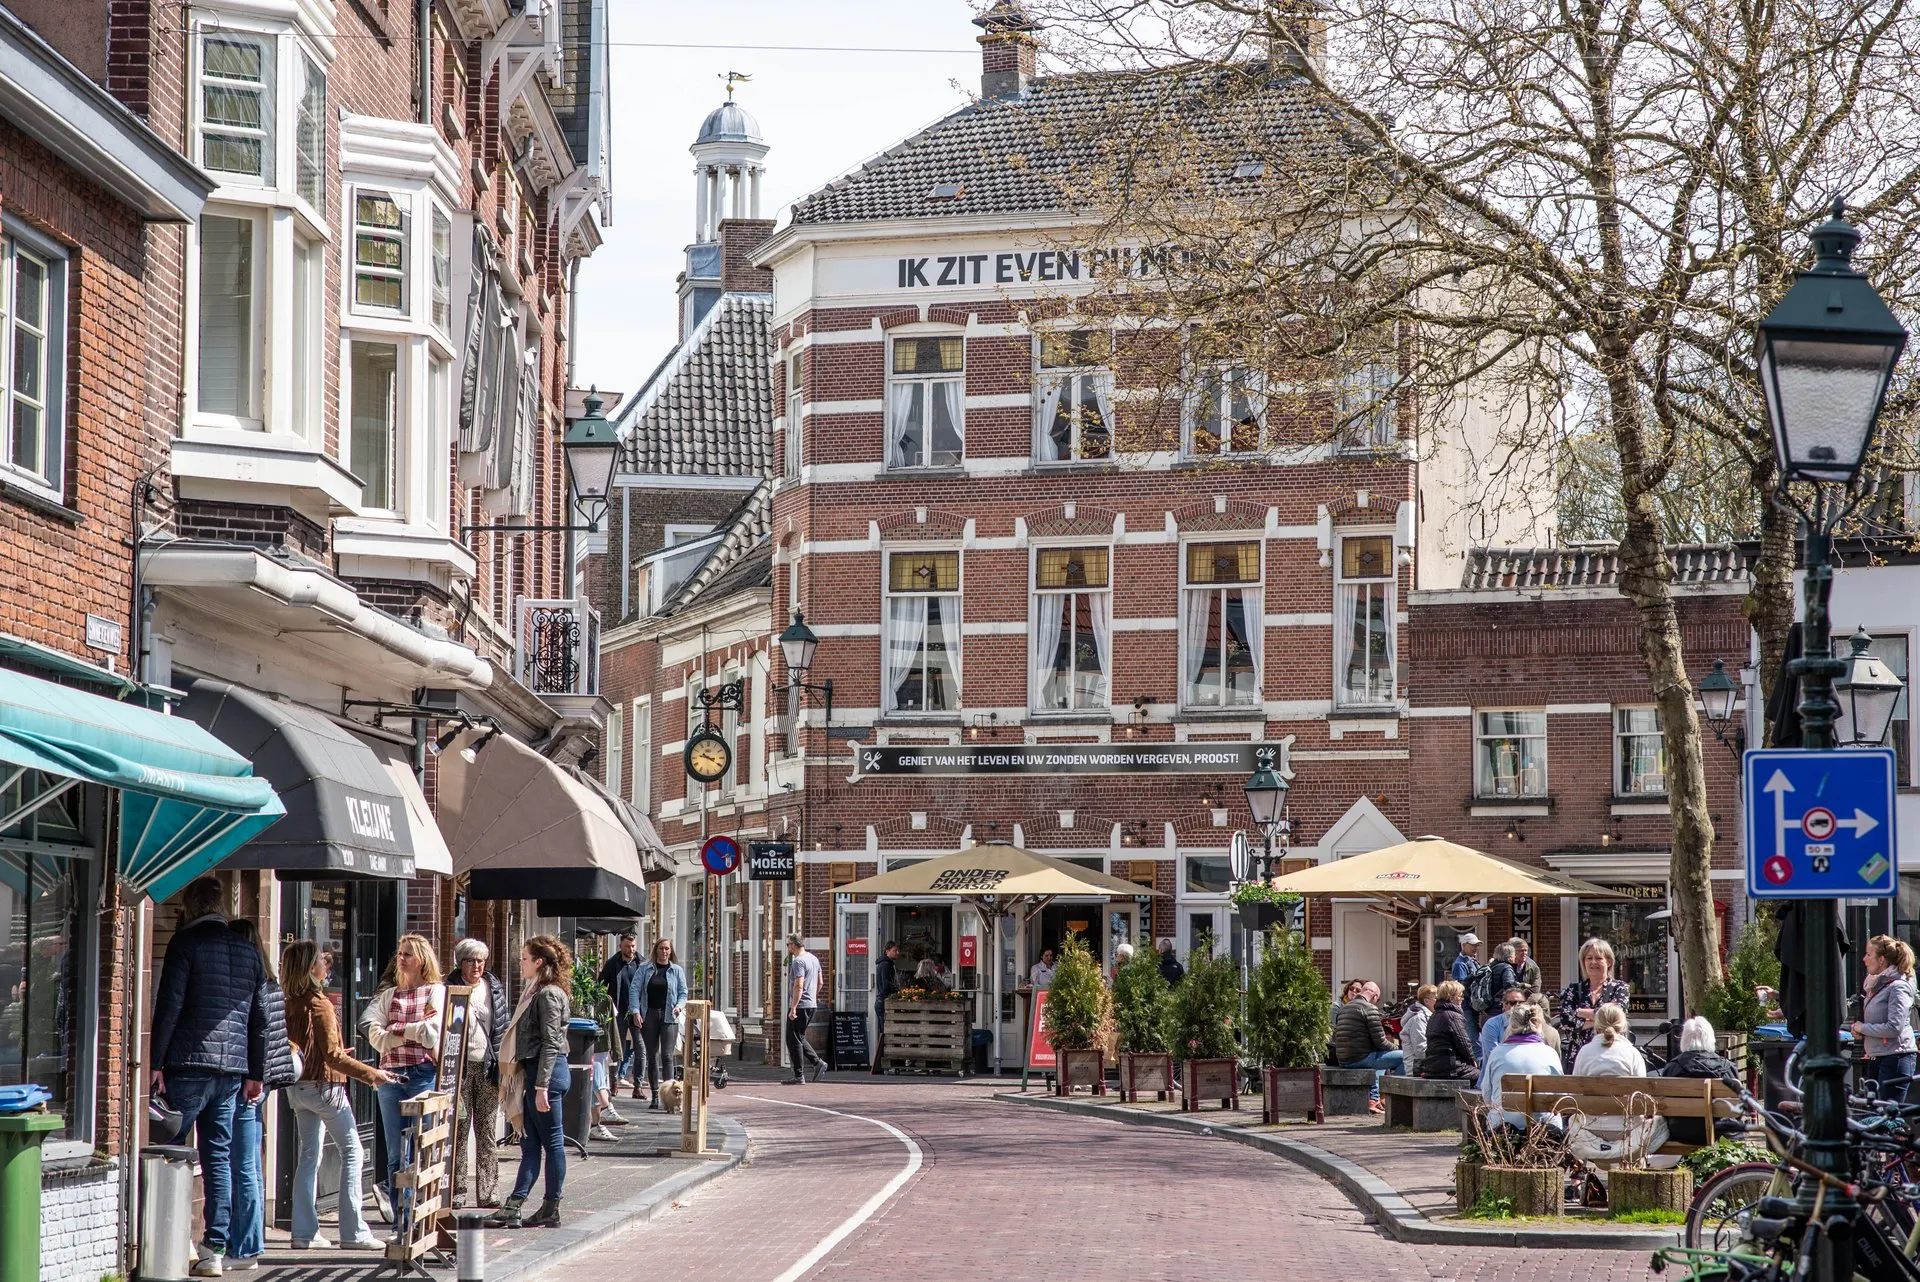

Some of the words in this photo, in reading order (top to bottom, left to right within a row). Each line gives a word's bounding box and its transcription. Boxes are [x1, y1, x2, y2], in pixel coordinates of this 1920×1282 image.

[898, 258, 930, 288] IK
[937, 255, 988, 286] ZIT
[995, 250, 1080, 283] EVEN
[899, 755, 933, 766] GENIET
[934, 755, 955, 766] VAN
[957, 755, 977, 765] HET
[978, 755, 1009, 765] LEVEN
[1011, 755, 1025, 765] EN
[1026, 754, 1045, 765] UW
[1045, 754, 1088, 765] ZONDEN
[1089, 754, 1134, 764] WORDEN
[1135, 753, 1192, 765] VERGEVEN,
[1194, 753, 1239, 764] PROOST!
[751, 858, 794, 869] MOEKE
[940, 869, 1010, 878] ONDER
